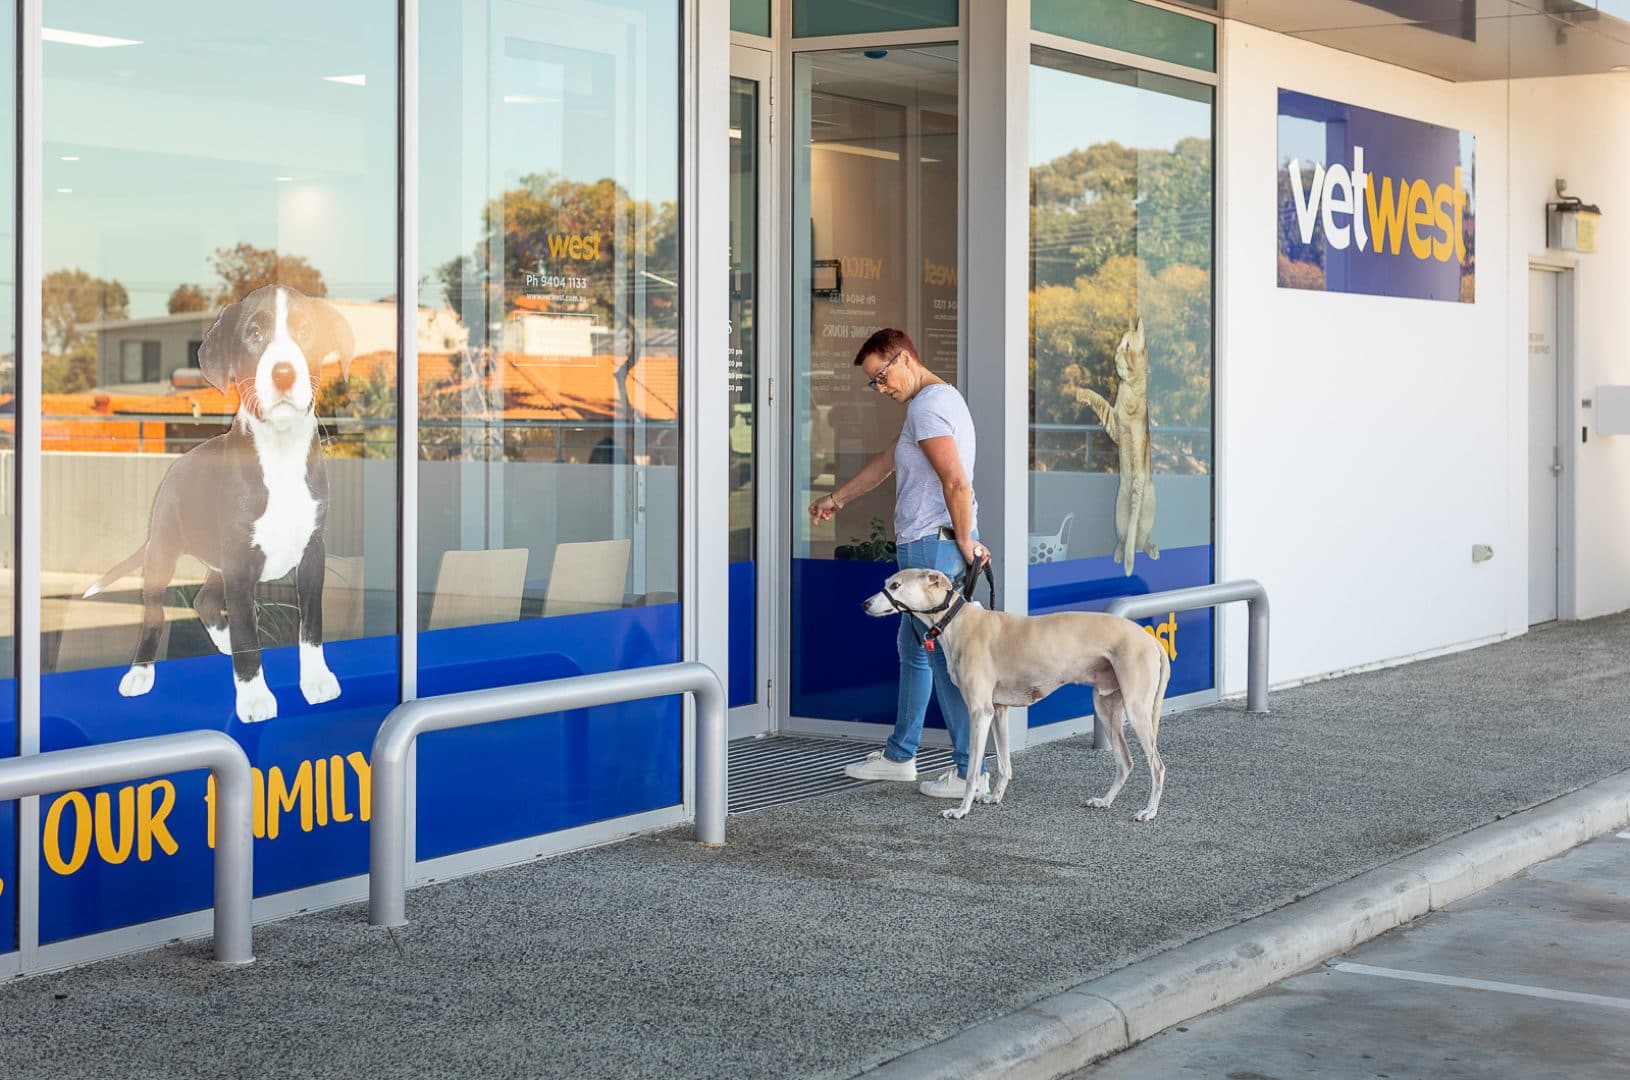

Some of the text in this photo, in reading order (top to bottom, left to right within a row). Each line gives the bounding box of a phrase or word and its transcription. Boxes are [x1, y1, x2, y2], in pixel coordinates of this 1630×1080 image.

[1288, 145, 1467, 263] vetwest
[548, 230, 601, 260] west
[526, 274, 587, 289] Ph 9404 1133
[1144, 612, 1178, 661] st
[43, 779, 179, 876] OUR
